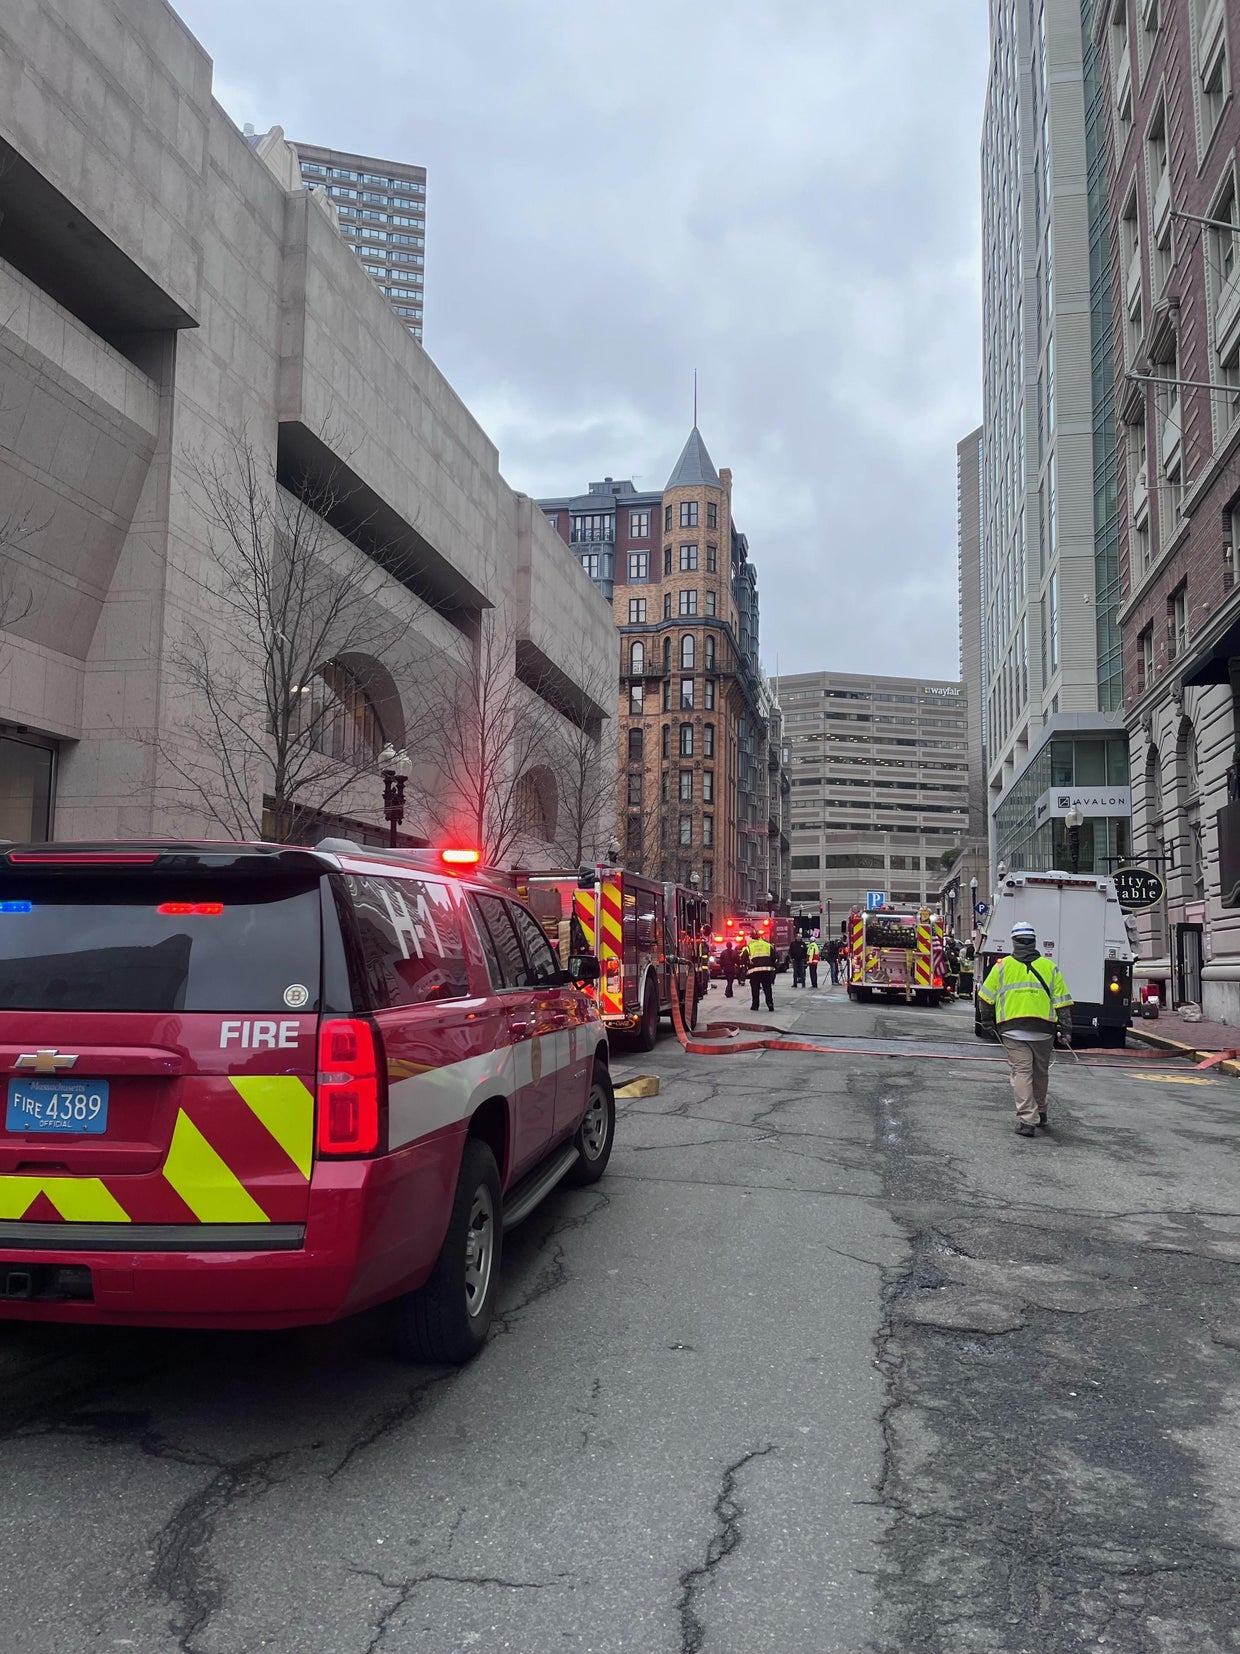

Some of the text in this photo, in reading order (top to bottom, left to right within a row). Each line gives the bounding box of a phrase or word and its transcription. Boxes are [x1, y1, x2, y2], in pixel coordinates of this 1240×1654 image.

[930, 687, 960, 696] wayfair
[1116, 888, 1156, 898] able
[872, 893, 881, 906] P
[978, 904, 985, 912] P
[381, 889, 445, 959] H-1
[220, 1020, 300, 1049] FIRE
[31, 1081, 86, 1092] Massachusetts
[14, 1093, 101, 1120] FIRE 4389
[40, 1120, 72, 1128] OFFICIAL
